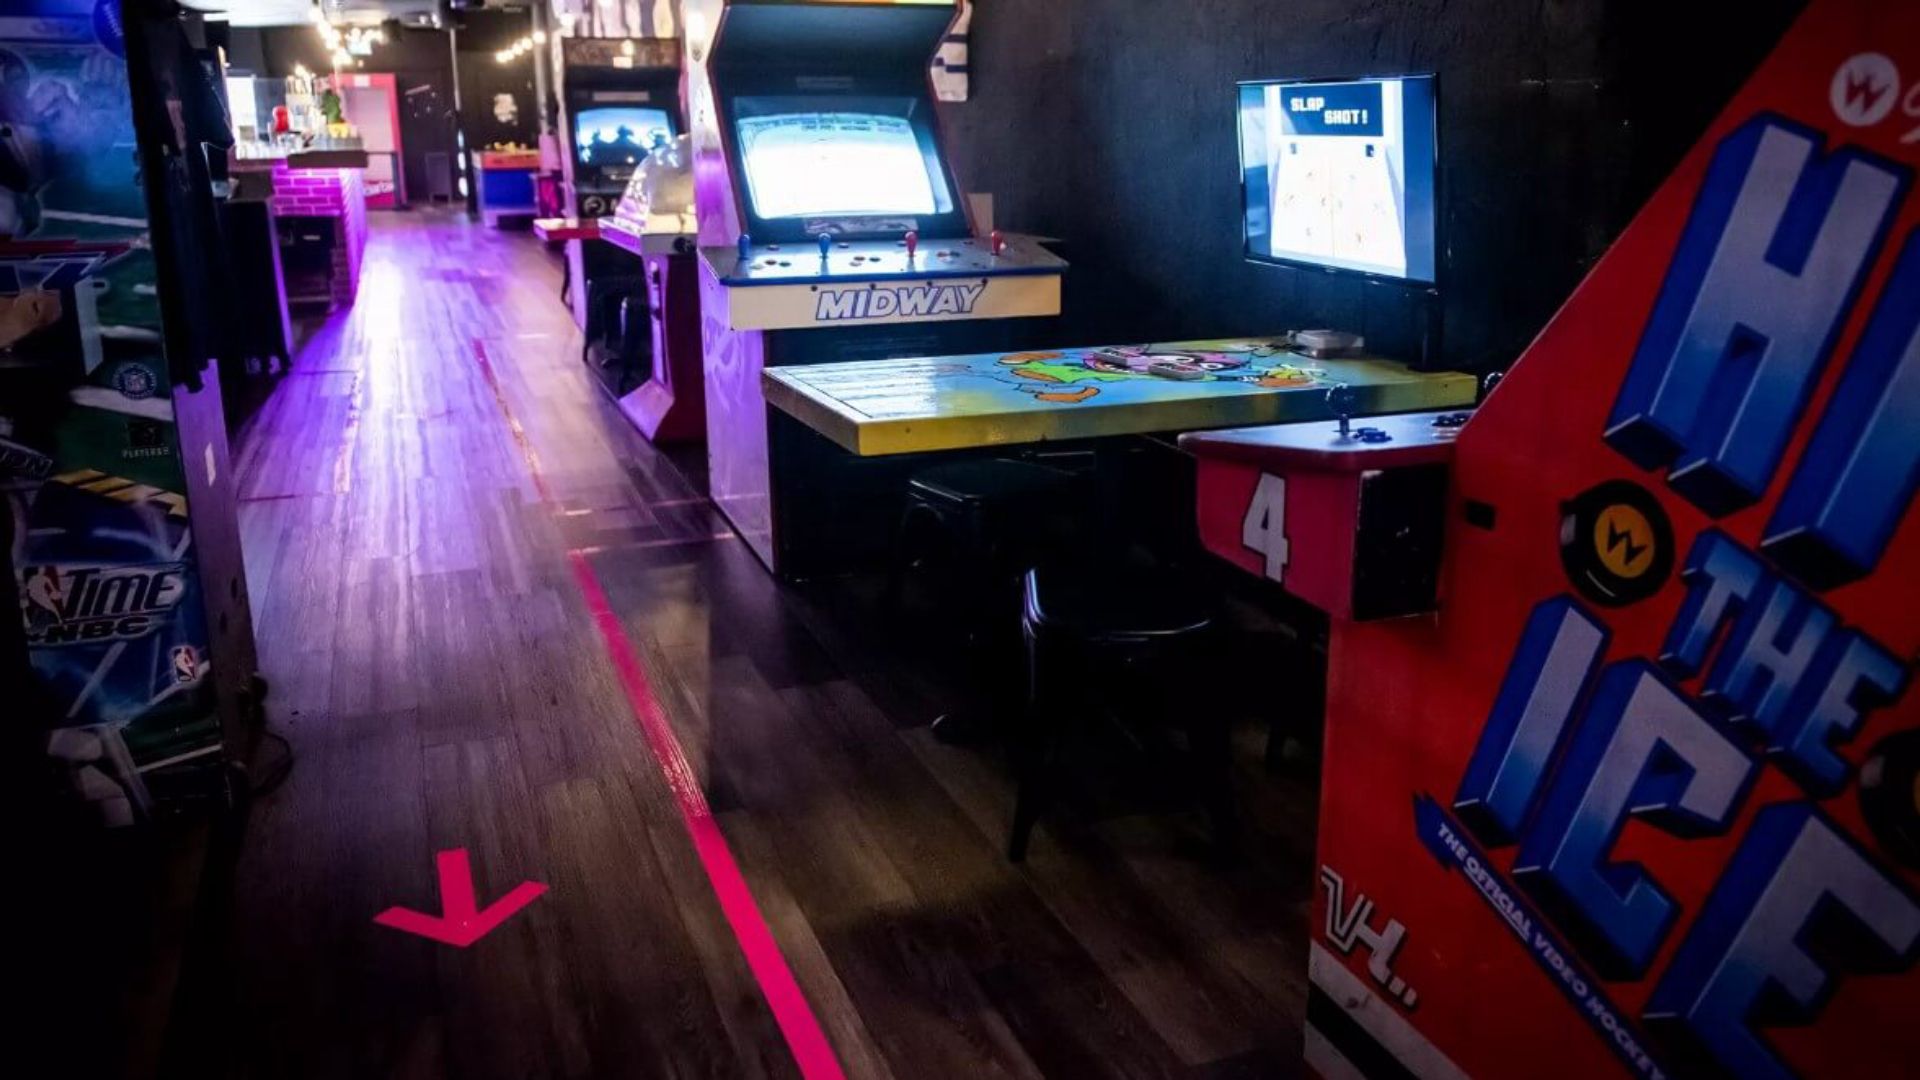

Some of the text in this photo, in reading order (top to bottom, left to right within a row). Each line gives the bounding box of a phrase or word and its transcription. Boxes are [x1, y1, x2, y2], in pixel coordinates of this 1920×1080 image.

[1290, 96, 1326, 112] SLAP
[815, 283, 988, 321] MIDWAY
[1241, 472, 1290, 583] 4
[46, 616, 149, 645] NBC
[1658, 528, 1912, 798] THE
[1452, 592, 1920, 1080] ICE
[1437, 821, 1470, 862] THE
[1463, 855, 1533, 944] OFFICIAL
[1534, 931, 1589, 998] VIDEO
